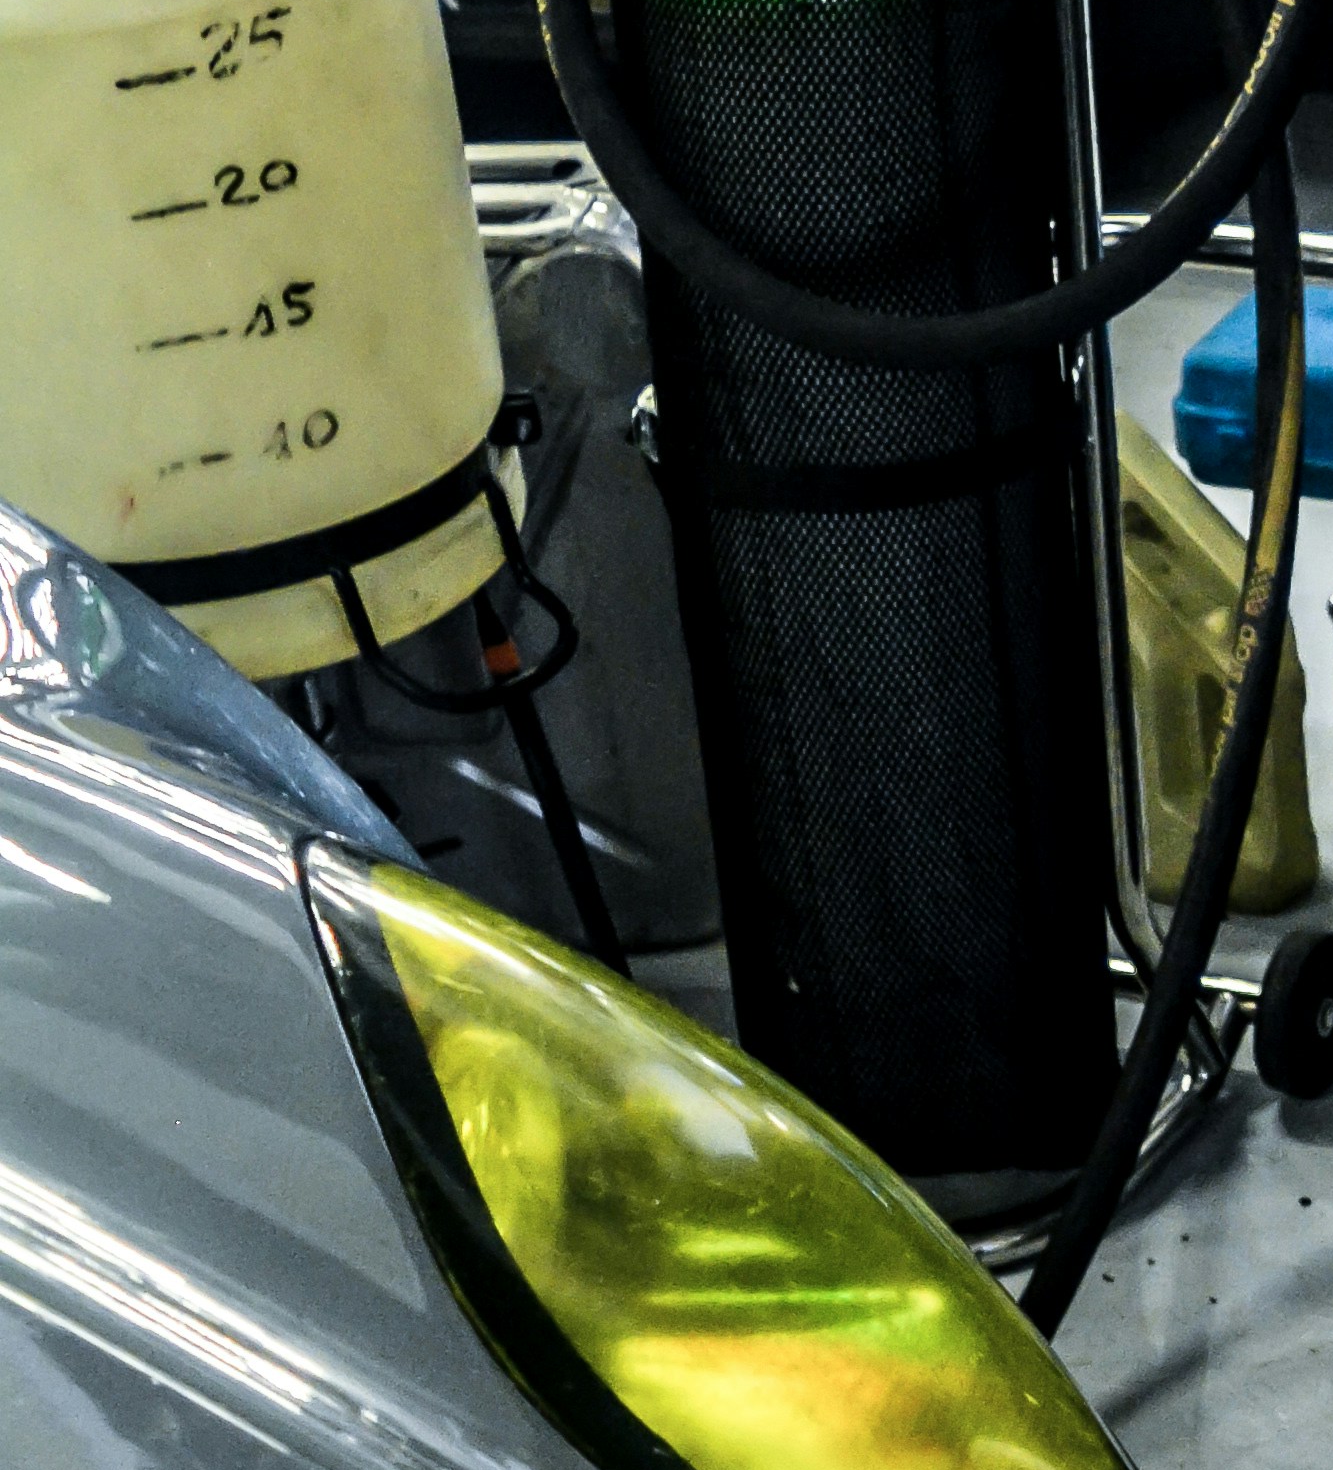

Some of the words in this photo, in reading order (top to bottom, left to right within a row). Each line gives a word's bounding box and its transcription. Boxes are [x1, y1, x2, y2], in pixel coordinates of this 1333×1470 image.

[201, 6, 292, 79] 25
[213, 159, 298, 206] 20
[241, 281, 316, 338] 15
[262, 409, 340, 461] 10
